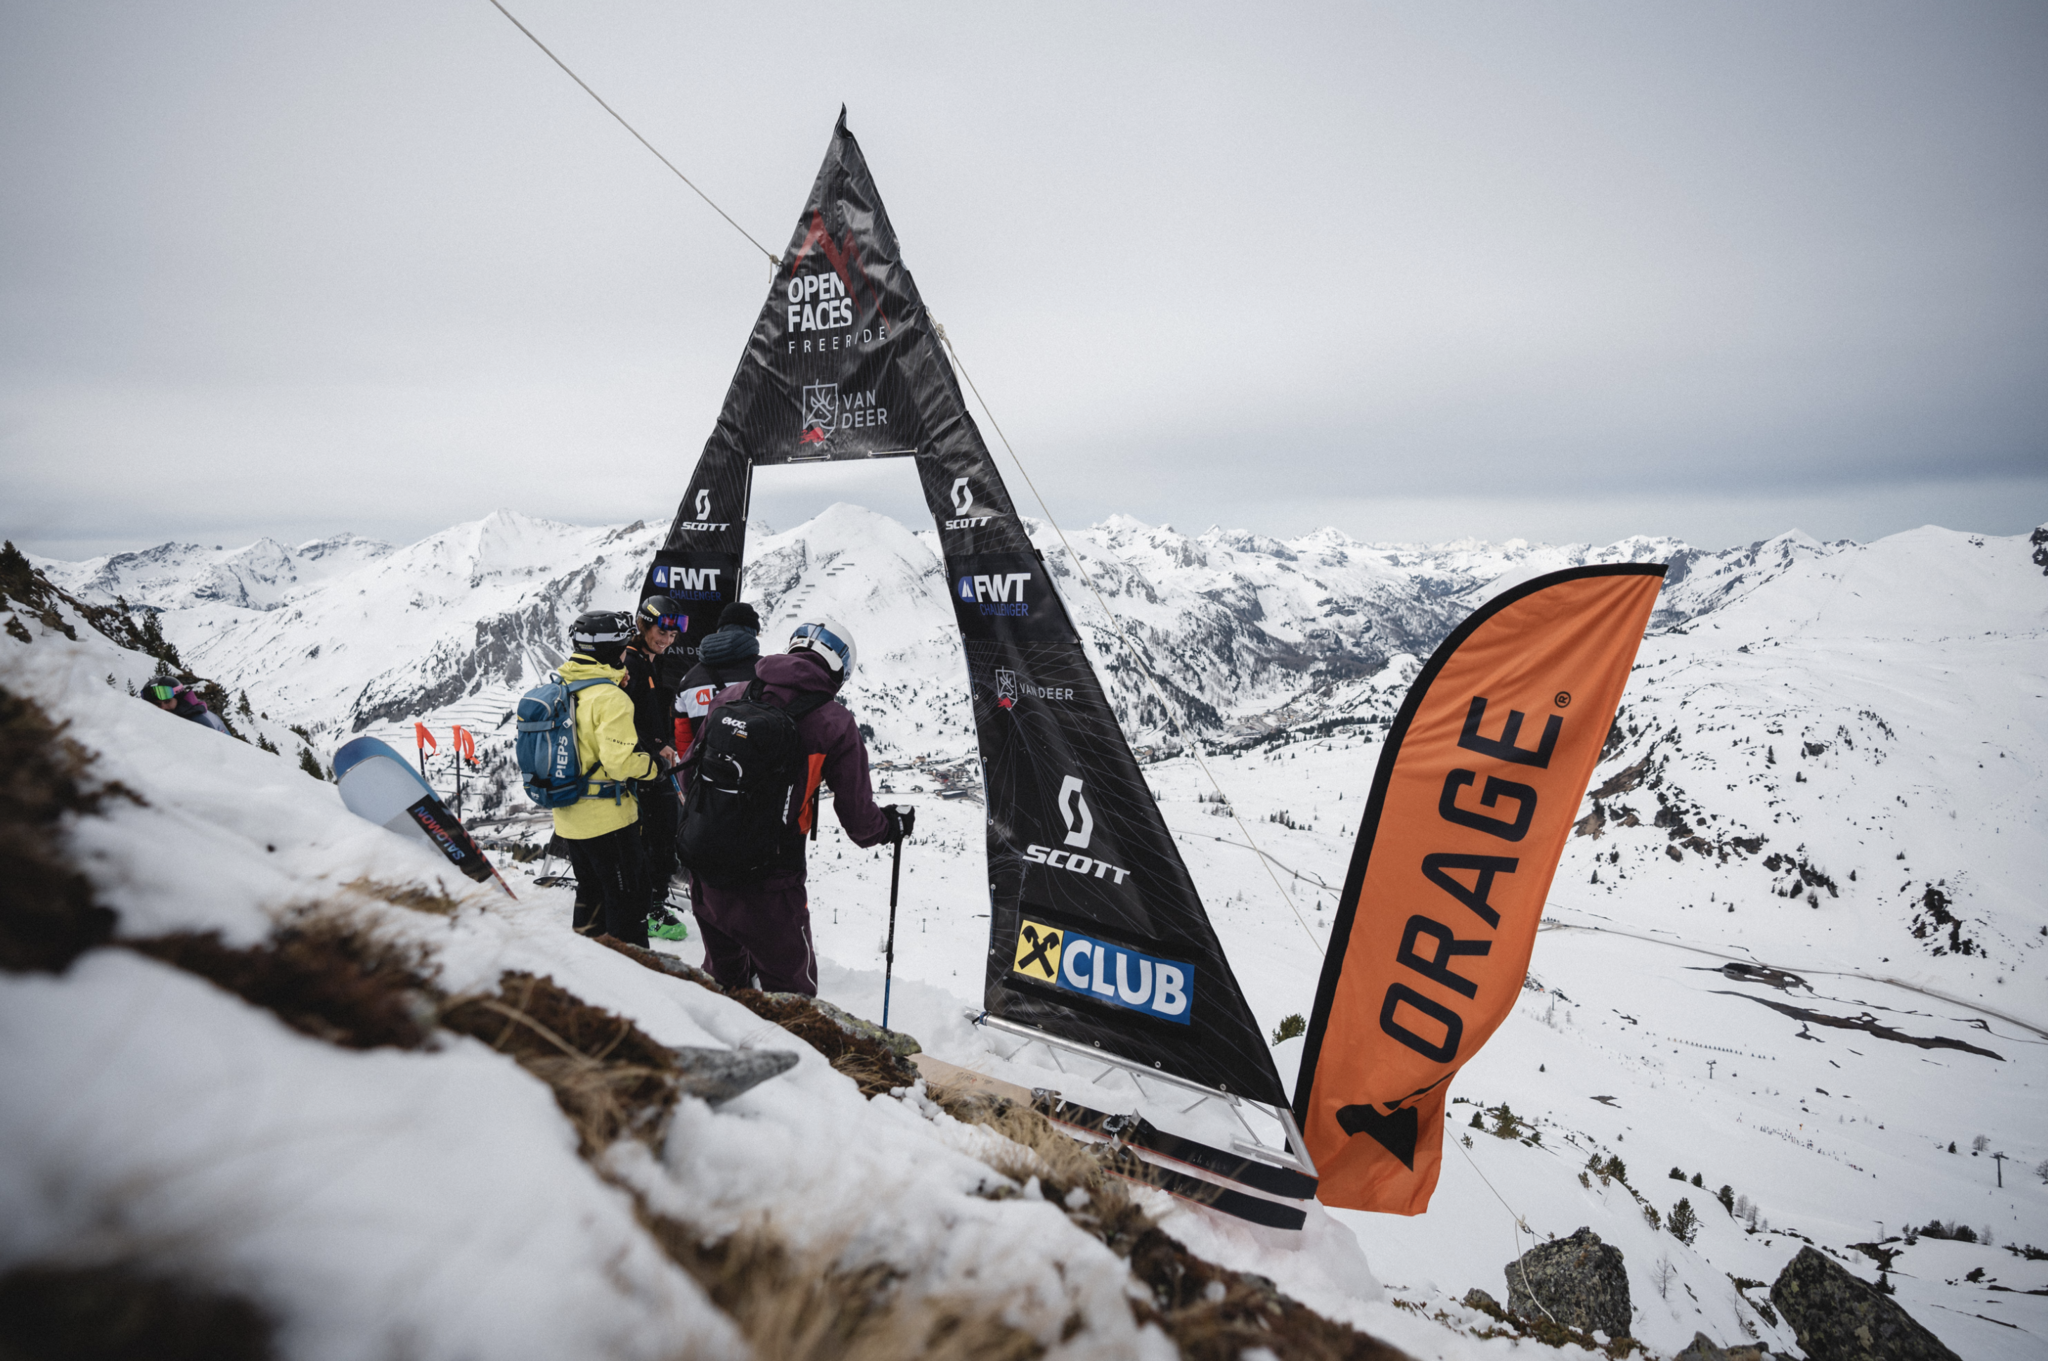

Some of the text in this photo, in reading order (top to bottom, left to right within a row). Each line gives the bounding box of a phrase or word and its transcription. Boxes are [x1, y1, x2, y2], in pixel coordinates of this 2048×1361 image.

[787, 271, 845, 303] OPEN
[788, 297, 852, 333] FACES
[788, 326, 886, 354] FREERIDE
[843, 389, 876, 410] VAN
[841, 408, 888, 429] DEER
[681, 521, 730, 532] SCOTT
[945, 516, 992, 530] SCOTT
[669, 566, 721, 591] FWT
[973, 573, 1031, 602] FWT
[669, 589, 722, 601] CHALLENGER
[979, 603, 1029, 616] CHALLENGER
[1019, 682, 1074, 700] VAN DEER
[555, 736, 569, 778] PIEPS
[414, 806, 466, 860] SALOMON
[1022, 844, 1131, 885] SCOTT
[1063, 939, 1187, 1016] CLUB
